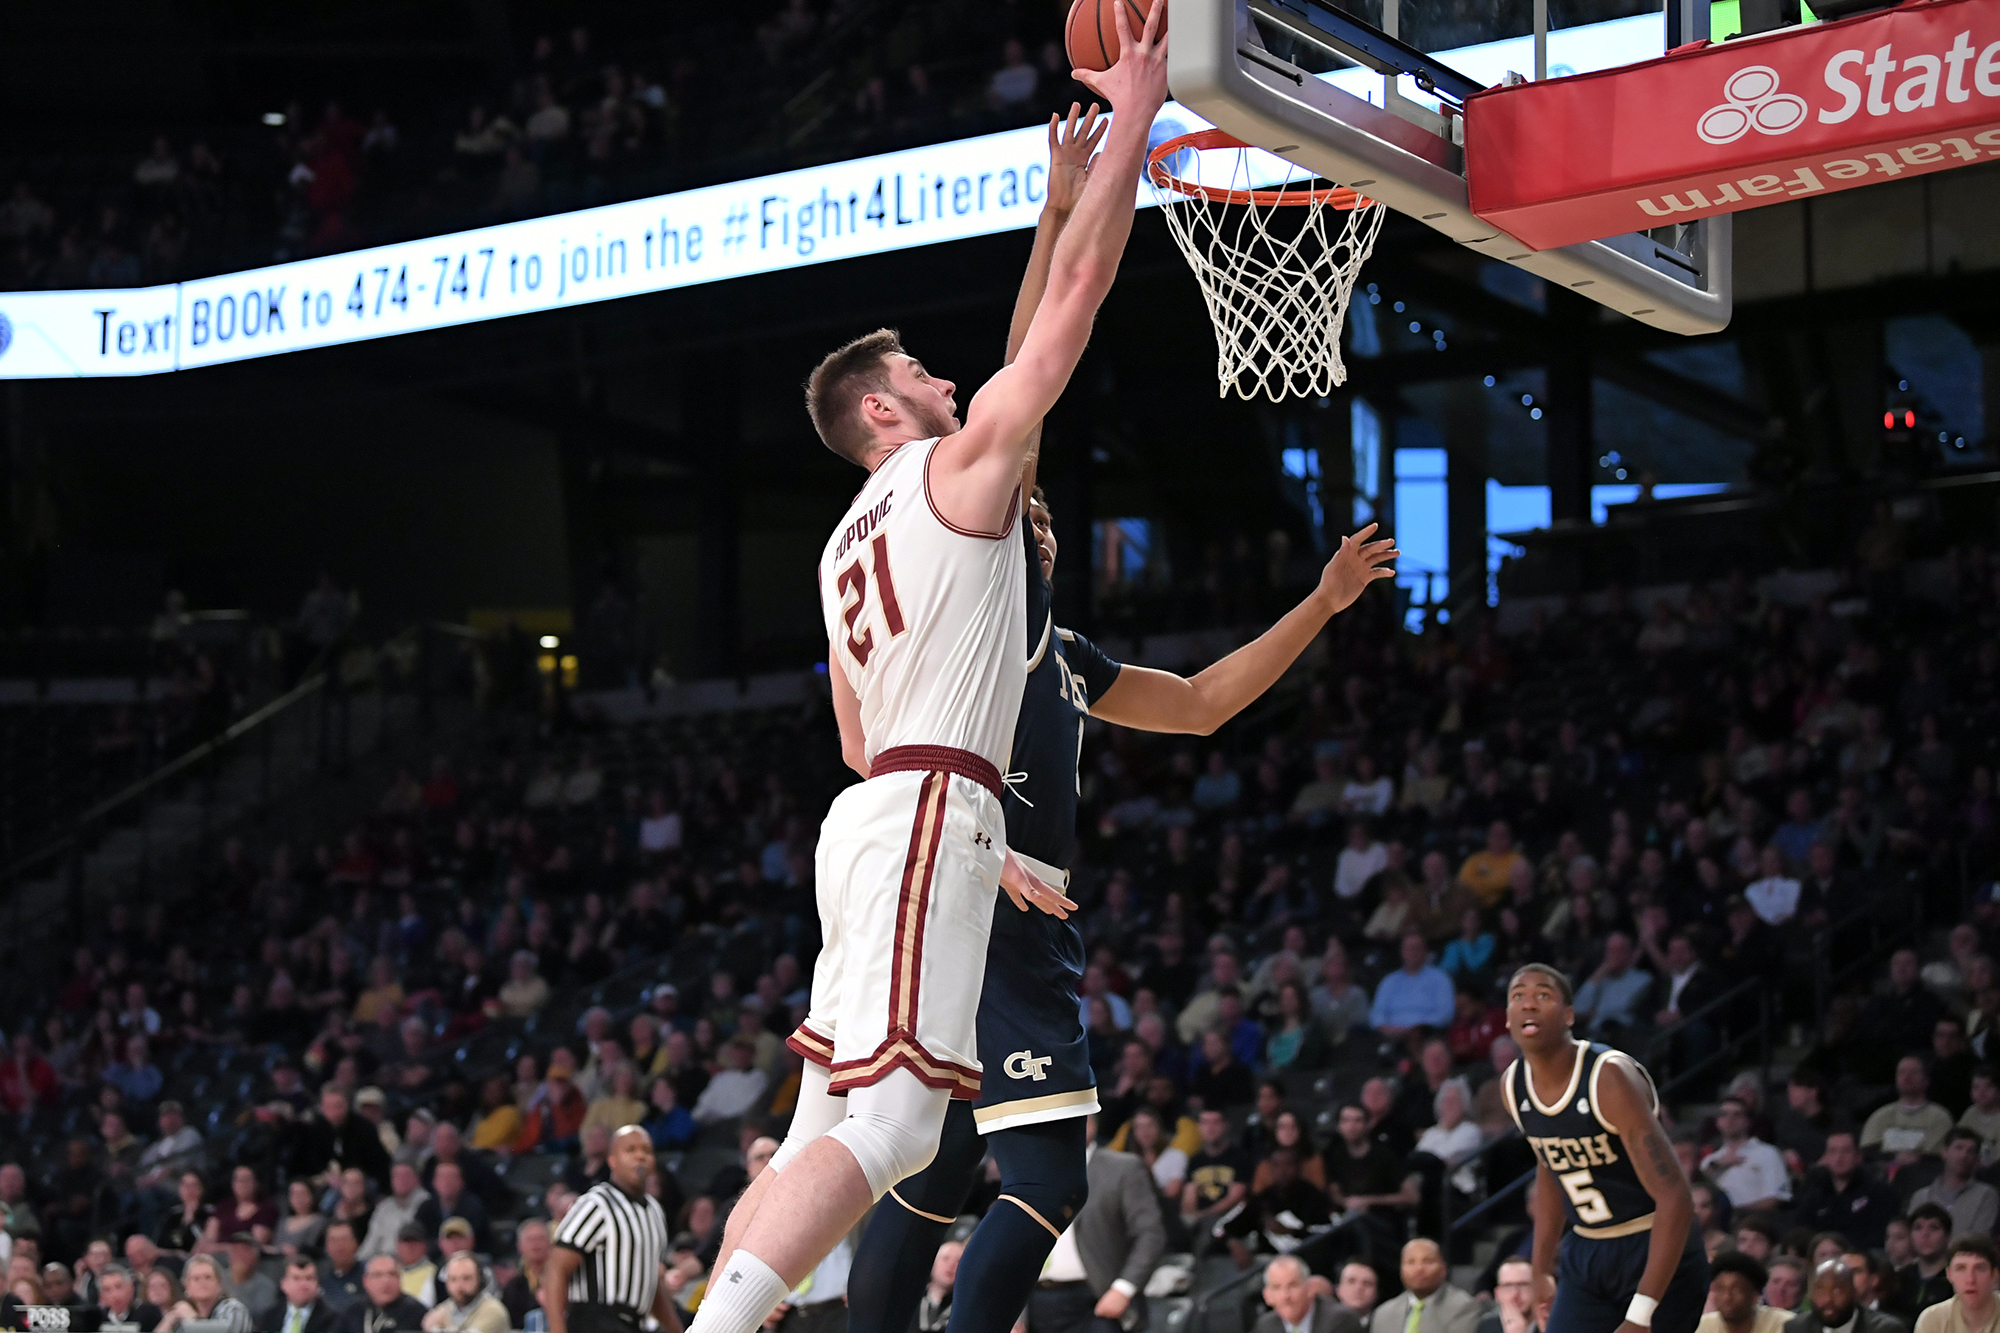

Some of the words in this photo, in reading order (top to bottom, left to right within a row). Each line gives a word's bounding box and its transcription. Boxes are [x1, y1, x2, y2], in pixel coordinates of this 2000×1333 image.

[1818, 30, 2000, 124] State
[95, 309, 175, 355] Text
[193, 286, 286, 345] BOOK
[301, 290, 332, 328] to
[346, 248, 495, 317] 474-747
[509, 255, 542, 293] to
[559, 235, 627, 297] join
[644, 218, 703, 268] the
[721, 161, 1045, 257] #Fight4Literac
[833, 489, 894, 569] POPOVIC
[836, 529, 908, 671] 21
[1003, 1050, 1052, 1081] GT
[1527, 1133, 1618, 1171] TECH
[1558, 1169, 1613, 1224] 5
